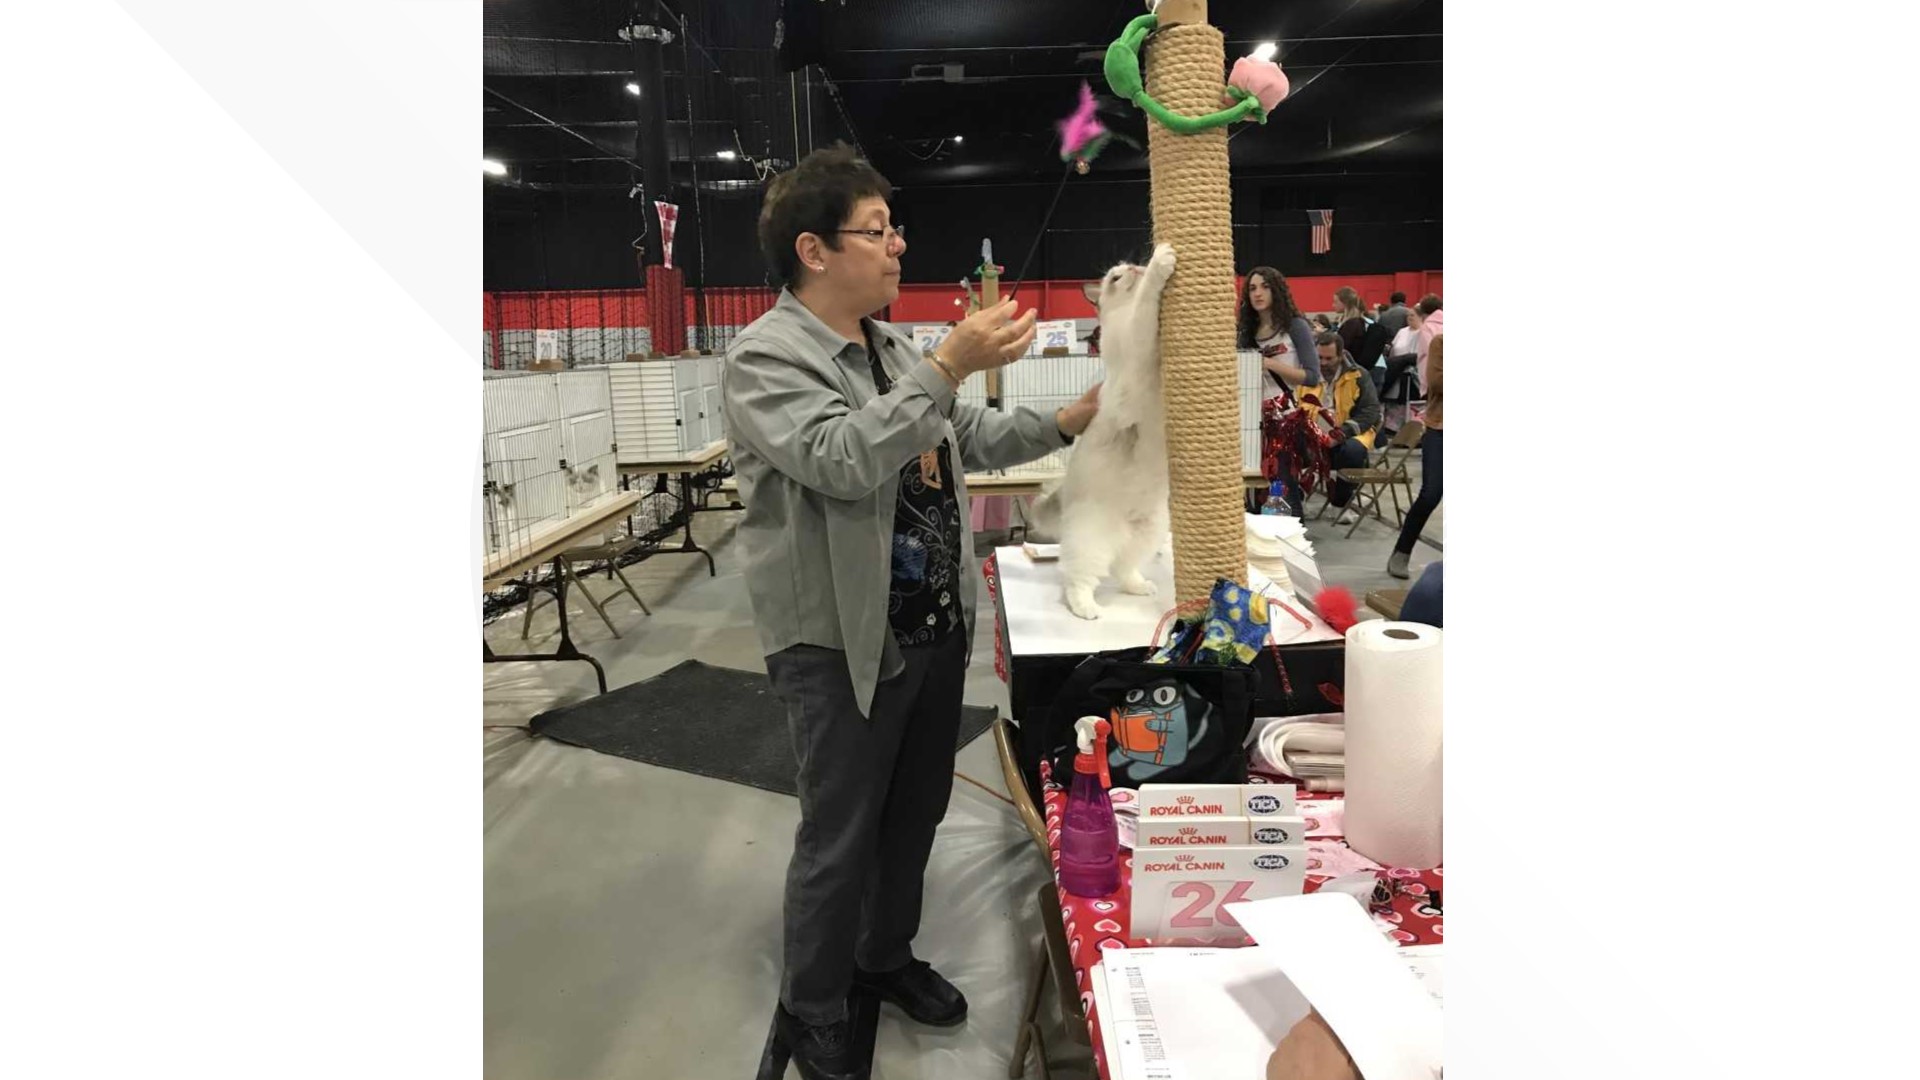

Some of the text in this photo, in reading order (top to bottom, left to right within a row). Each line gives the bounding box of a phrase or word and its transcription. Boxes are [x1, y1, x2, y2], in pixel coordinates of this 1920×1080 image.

[1046, 331, 1068, 347] 25
[1150, 804, 1223, 816] ROYAL CANIN
[1249, 798, 1279, 811] TICA
[1149, 835, 1227, 845] ROYAL CANIN
[1254, 831, 1285, 842] TICA
[1144, 862, 1226, 872] ROYAL CANIN
[1254, 856, 1287, 868] TICA
